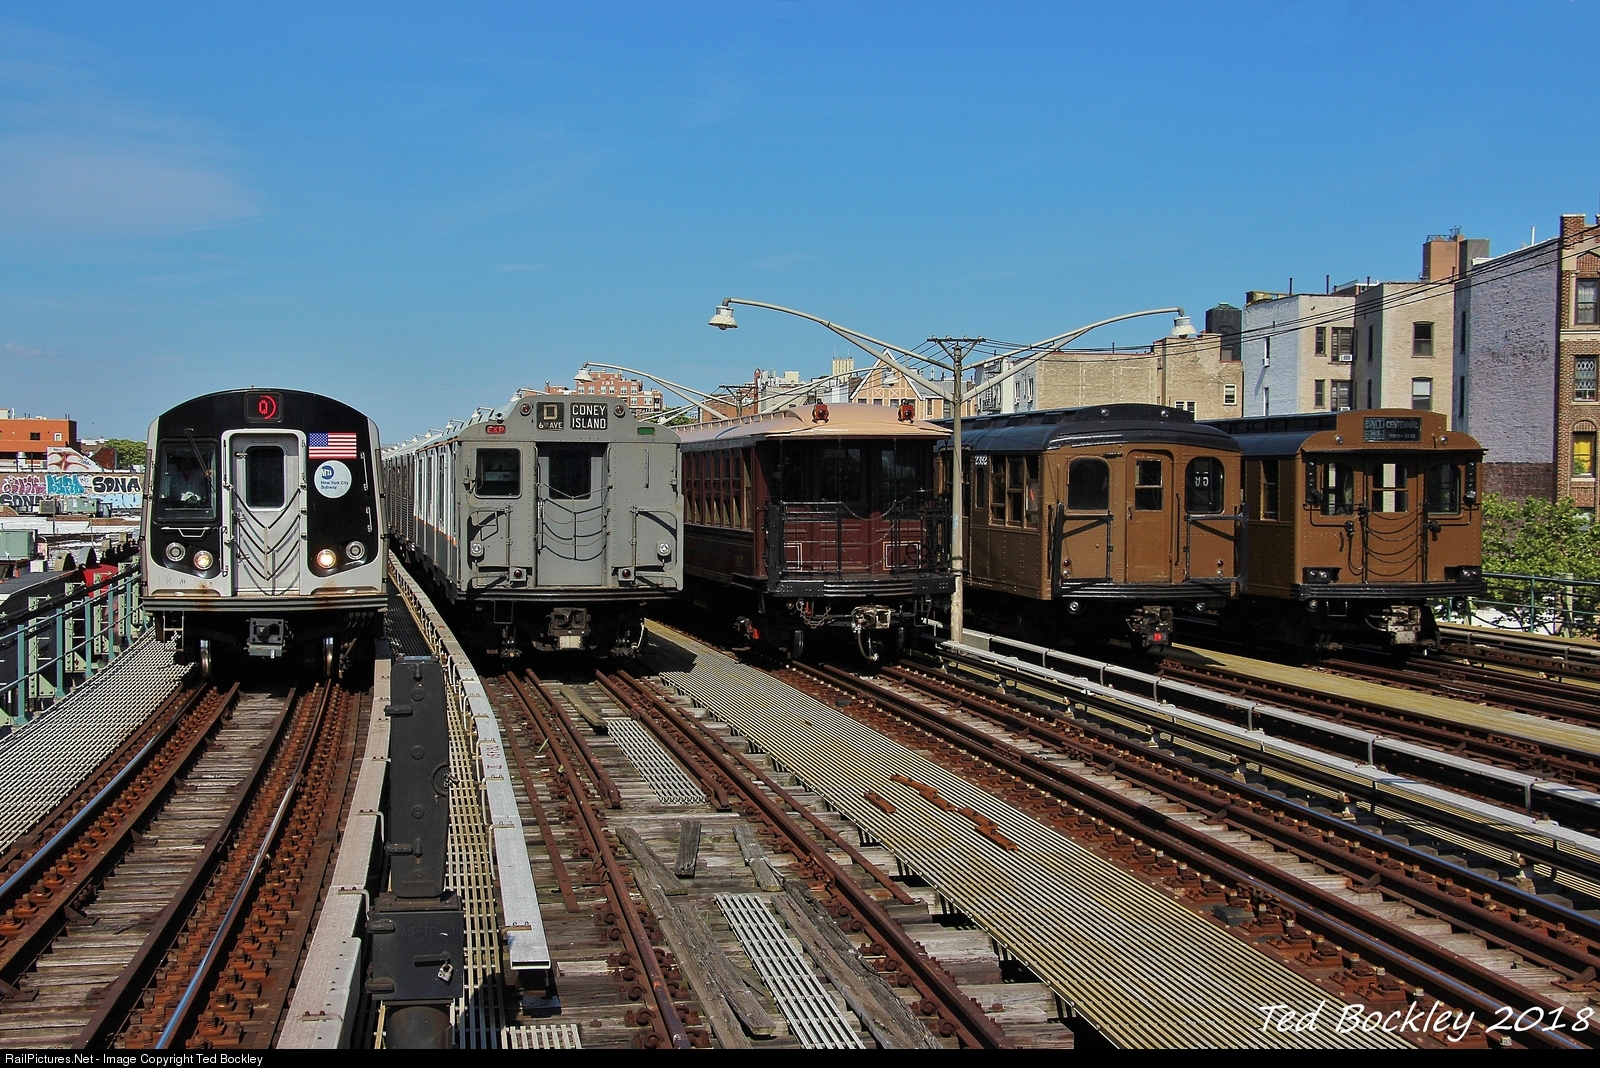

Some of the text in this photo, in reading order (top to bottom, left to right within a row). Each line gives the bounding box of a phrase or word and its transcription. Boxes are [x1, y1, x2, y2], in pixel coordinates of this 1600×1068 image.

[572, 404, 606, 416] CONEY
[572, 418, 606, 429] ISLAND
[1365, 419, 1384, 428] BMT
[1386, 420, 1419, 429] CENTENNIAL
[487, 426, 505, 434] EXP
[92, 475, 142, 494] SONA
